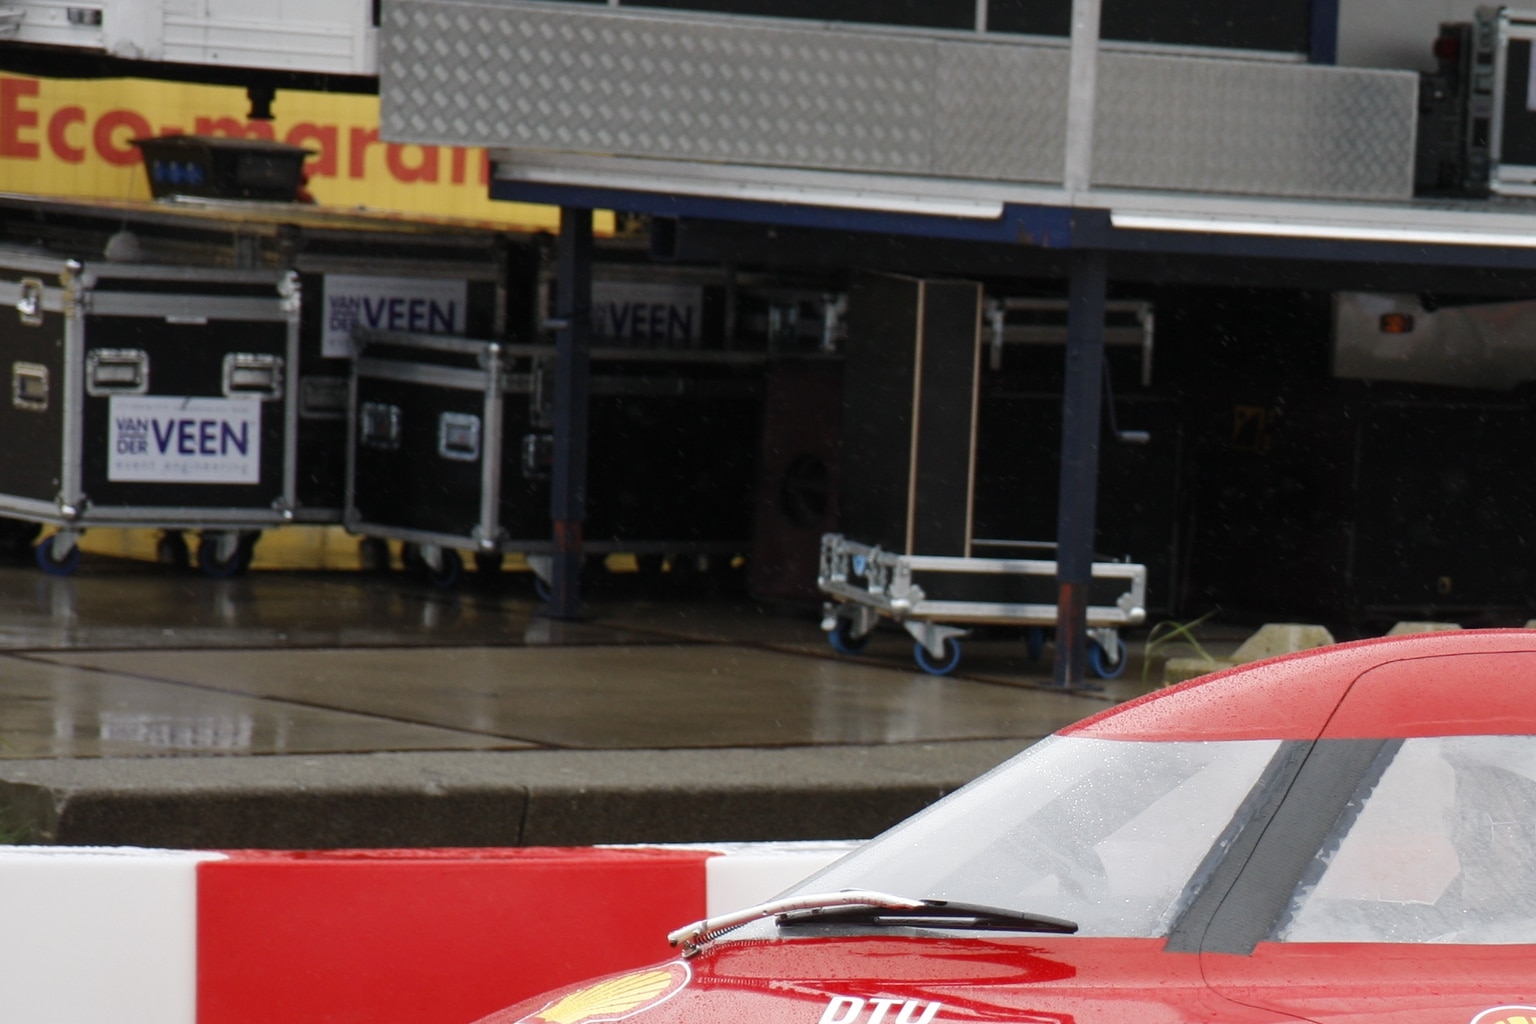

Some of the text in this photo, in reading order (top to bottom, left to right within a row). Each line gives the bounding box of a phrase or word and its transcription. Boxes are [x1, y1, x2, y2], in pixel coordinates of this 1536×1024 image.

[363, 296, 455, 331] VEEN
[610, 302, 692, 340] VEEN
[116, 417, 148, 431] VAN
[152, 418, 249, 456] VEEN
[117, 439, 148, 455] DER
